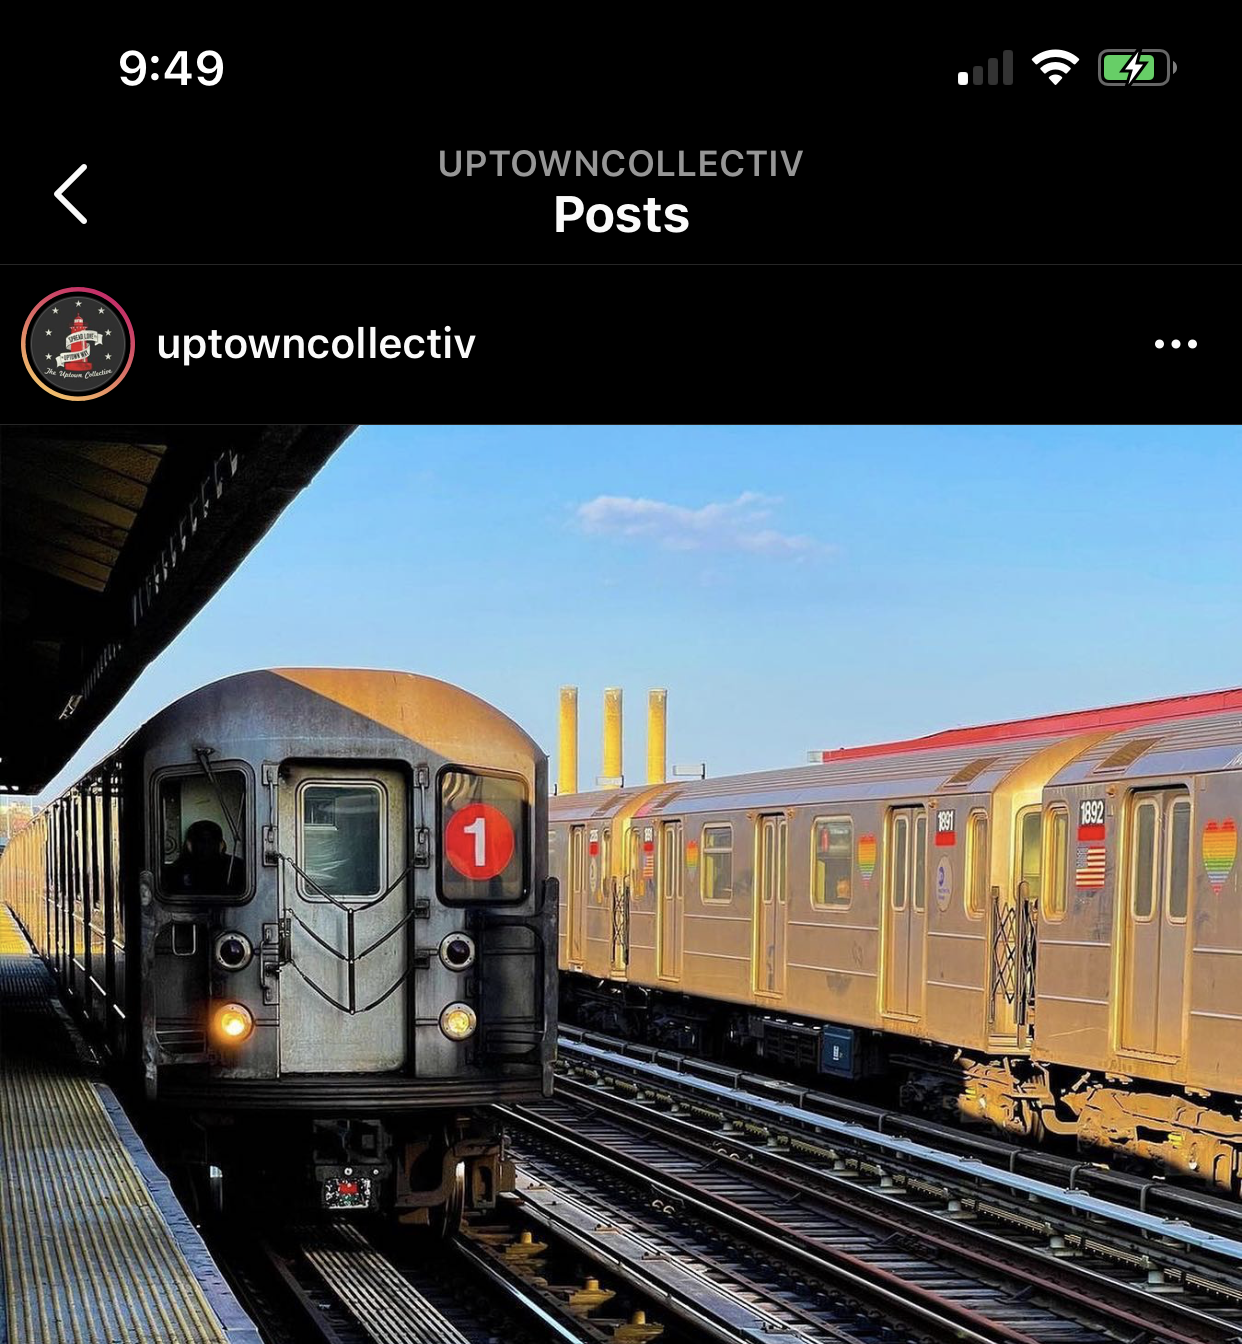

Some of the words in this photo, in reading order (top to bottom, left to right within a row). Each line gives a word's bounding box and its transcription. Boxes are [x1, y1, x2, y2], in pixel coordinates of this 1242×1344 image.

[120, 50, 223, 86] 9:49
[440, 150, 803, 177] UPTOWNCOLLECTIV
[556, 196, 689, 233] Posts
[159, 326, 476, 366] uptowncollectiv
[44, 367, 57, 376] The
[58, 370, 83, 379] Uptown
[84, 368, 113, 379] Collective
[938, 810, 954, 832] 1891
[1080, 800, 1104, 825] 1892
[463, 817, 486, 867] 1
